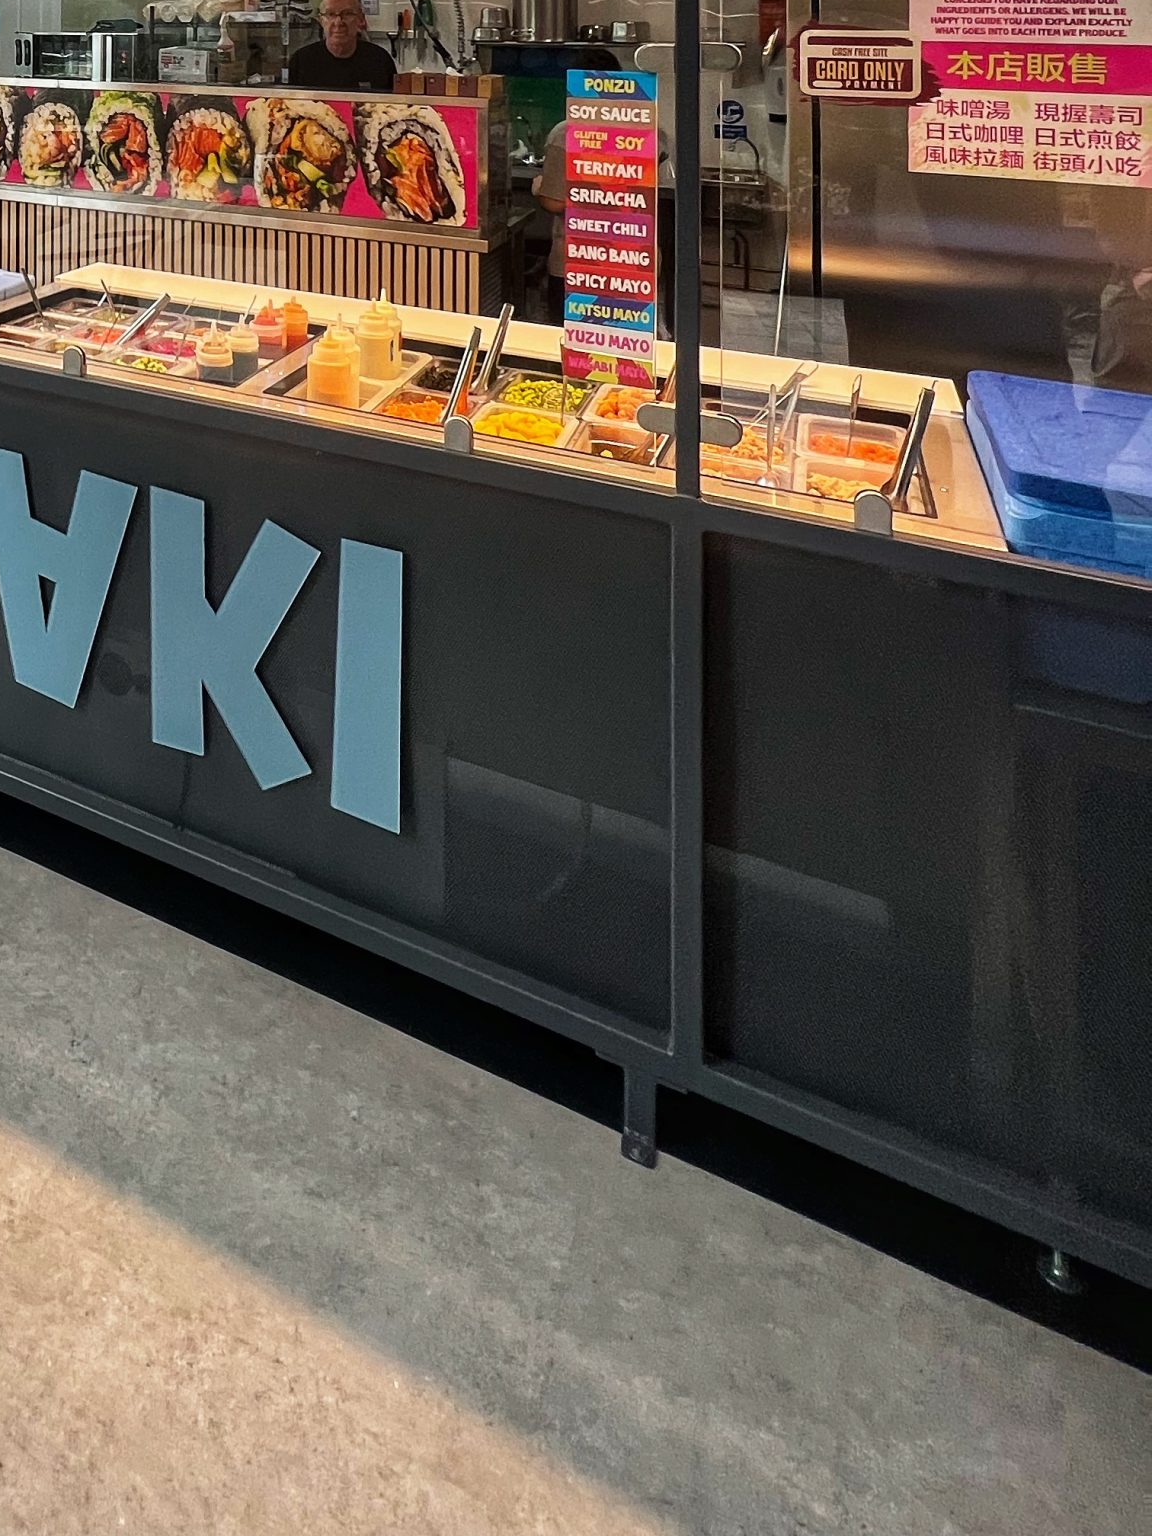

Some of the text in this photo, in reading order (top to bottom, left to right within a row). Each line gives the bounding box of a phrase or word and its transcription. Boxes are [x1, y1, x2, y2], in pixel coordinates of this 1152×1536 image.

[930, 17, 1133, 26] HAPPY TO GUIDE YOU AND EXPLAIN EXACTLY
[936, 7, 1127, 15] INGREDIENTS OR ALLERGENS. WE WILL BE
[935, 27, 1127, 37] WHAT GOES INTO EACH ITEM WE PRODUCE.
[832, 47, 888, 57] CASH FREE SITE
[815, 60, 905, 81] CARD ONLY
[946, 50, 1108, 85] 本店販售
[583, 78, 635, 94] PONZU
[846, 80, 902, 90] PAYMENT
[569, 104, 651, 123] SOY SAUCE
[1034, 102, 1143, 126] 現握壽司
[573, 130, 608, 141] GLUTEN
[579, 140, 603, 150] FREE
[615, 135, 645, 151] SOY
[926, 122, 1142, 151] 日式咖哩 日式煎餃
[572, 159, 643, 180] TERIYAKI
[924, 145, 1142, 177] 風味拉麵 街頭小吃
[569, 187, 647, 209] SRIRACHA
[568, 217, 647, 238] SWEET CHILI
[567, 244, 650, 267] BANG BANG
[566, 271, 652, 295] SPICY MAYO
[568, 301, 650, 324] KATSU MAYO
[565, 328, 650, 353] YUZU MAYO
